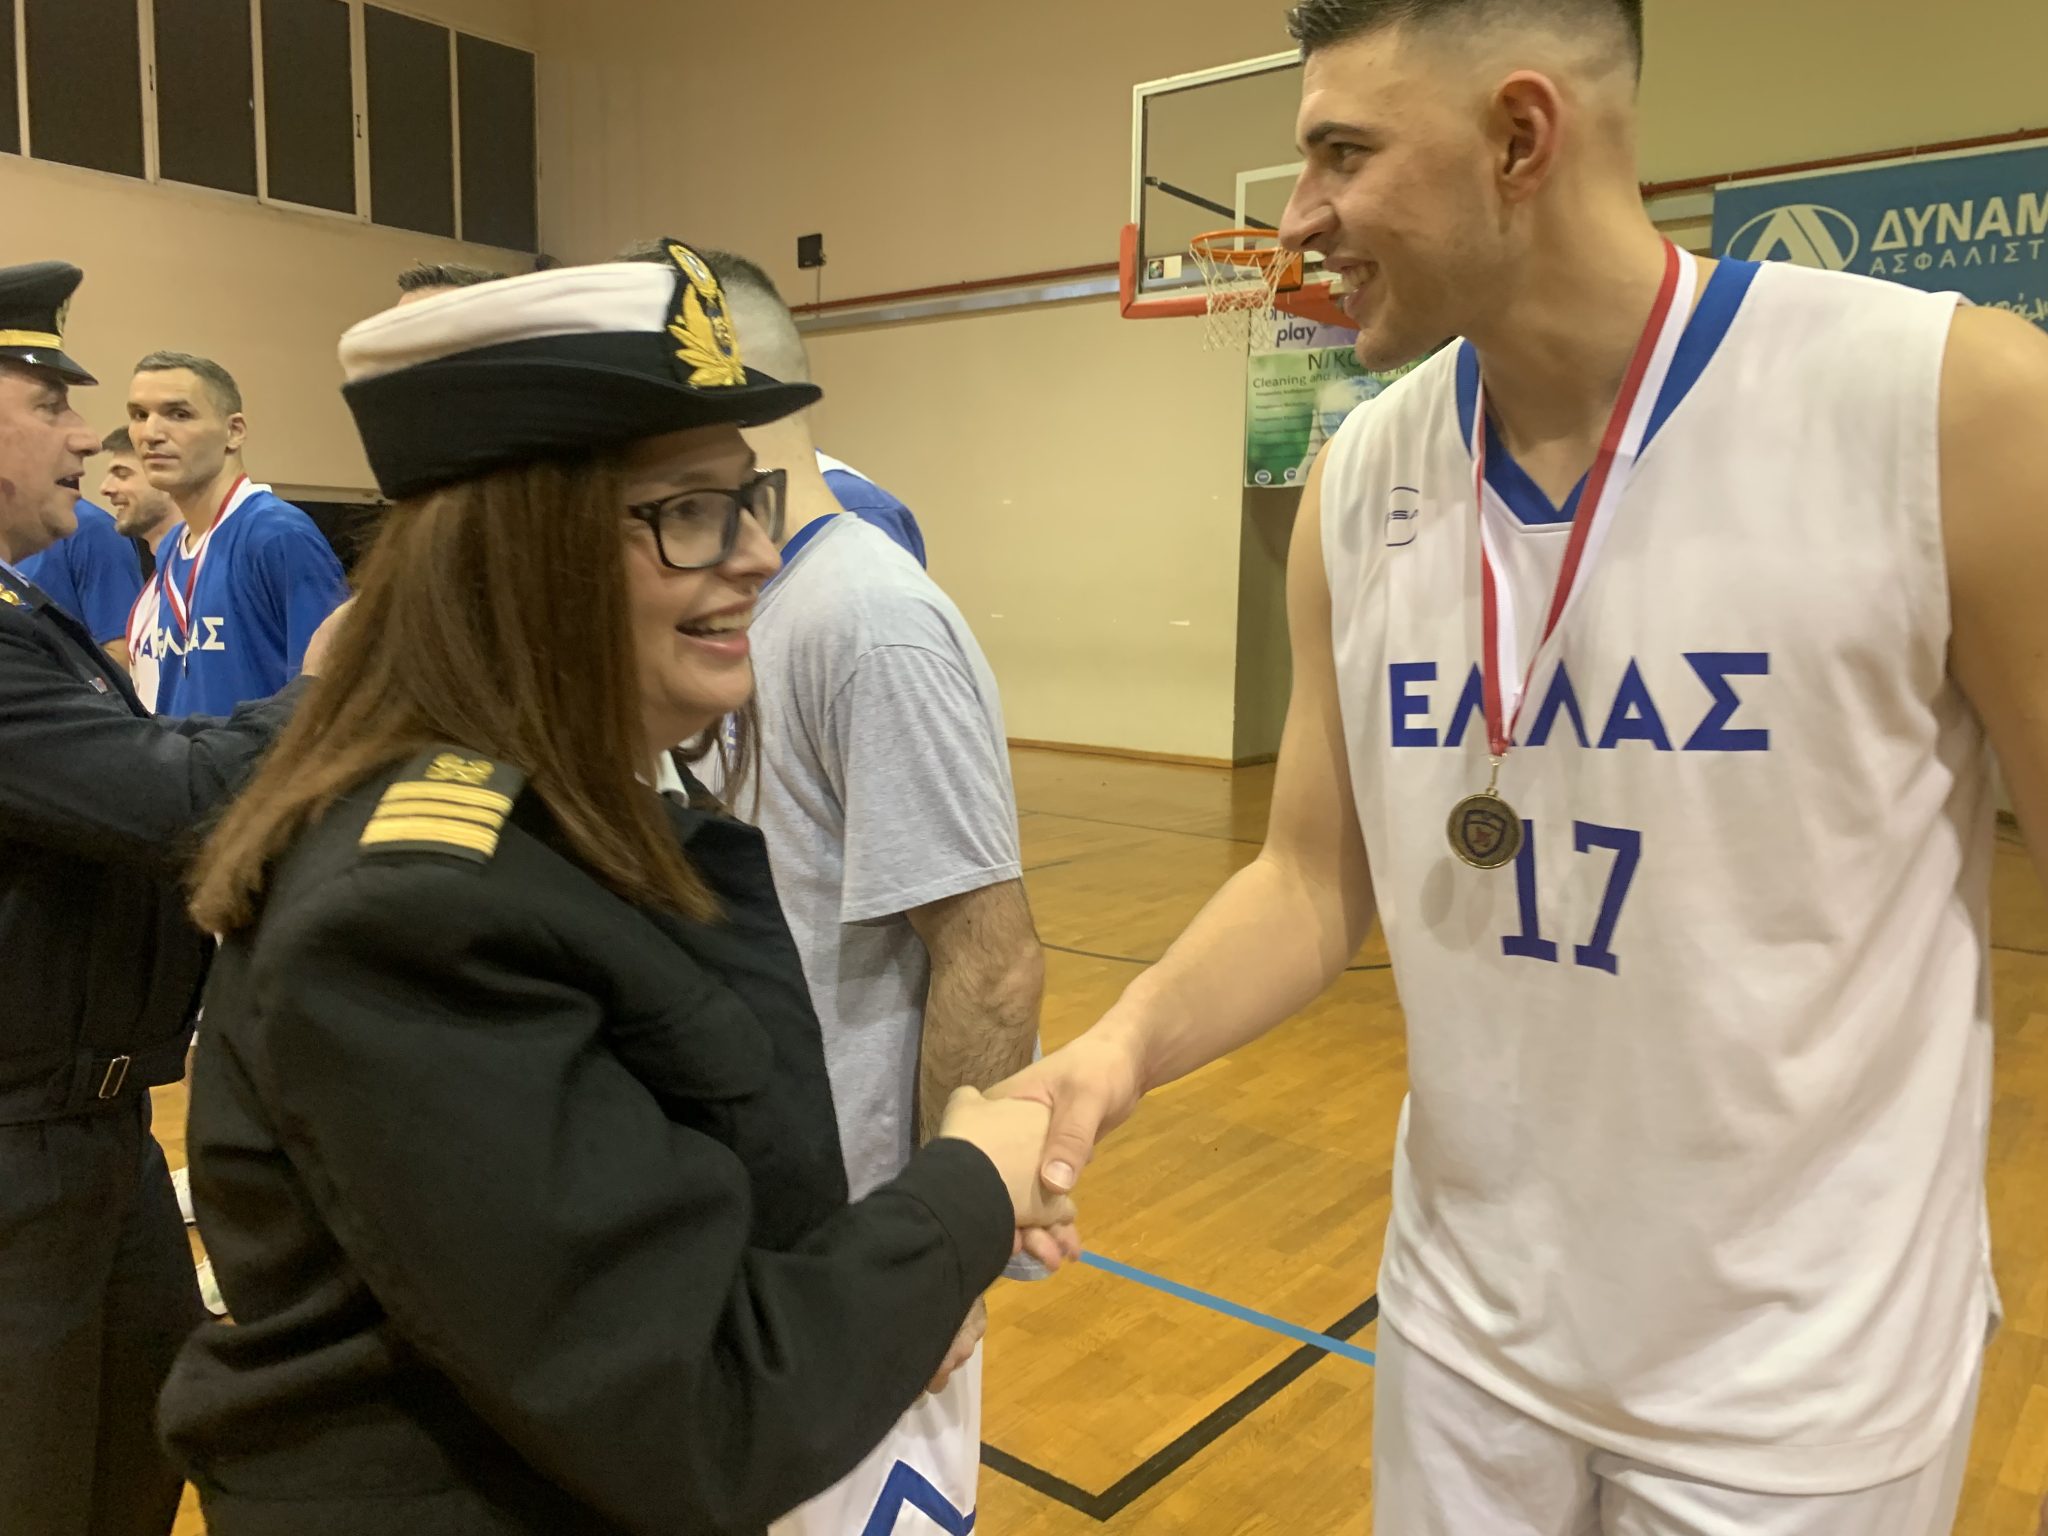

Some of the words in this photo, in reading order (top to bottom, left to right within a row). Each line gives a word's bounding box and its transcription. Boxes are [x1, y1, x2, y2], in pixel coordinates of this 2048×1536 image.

[1276, 321, 1318, 348] play
[1252, 374, 1307, 390] Cleaning
[1309, 371, 1331, 383] and
[1500, 818, 1643, 976] 17
